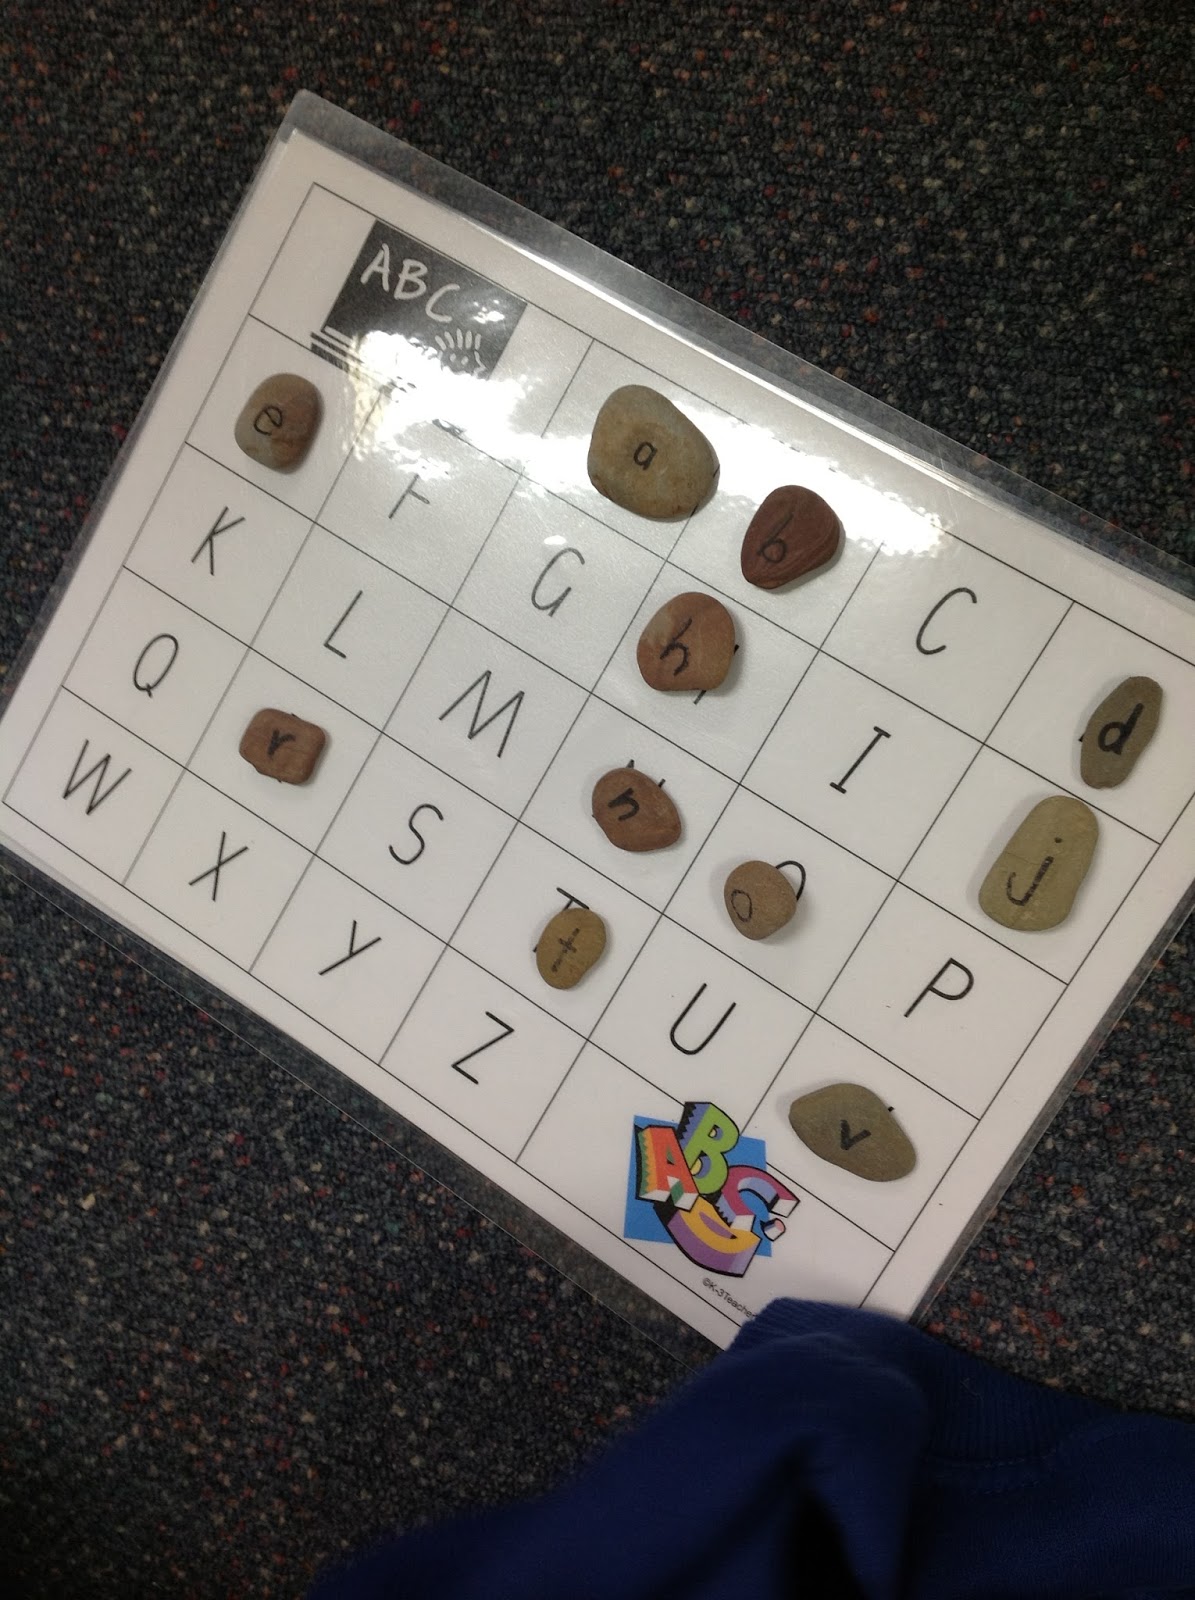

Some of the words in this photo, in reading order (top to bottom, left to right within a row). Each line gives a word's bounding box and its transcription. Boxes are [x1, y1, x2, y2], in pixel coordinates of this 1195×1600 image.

[361, 243, 461, 323] ABC
[253, 404, 284, 436] e
[633, 441, 657, 470] a
[191, 506, 246, 576] K
[757, 511, 794, 564] b
[531, 548, 585, 617] G
[324, 590, 363, 659] L
[660, 617, 693, 677] h
[916, 587, 978, 656] C
[133, 633, 179, 698] Q
[267, 728, 296, 758] r
[438, 670, 525, 758] M
[1097, 702, 1145, 755] d
[62, 739, 132, 816] W
[829, 726, 892, 794] I
[388, 803, 444, 866] S
[608, 787, 640, 821] n
[188, 831, 249, 902] X
[1006, 837, 1063, 906] j
[318, 920, 382, 976] Y
[551, 927, 580, 973] t
[670, 983, 737, 1056] U
[904, 957, 975, 1018] P
[451, 1011, 515, 1085] Z
